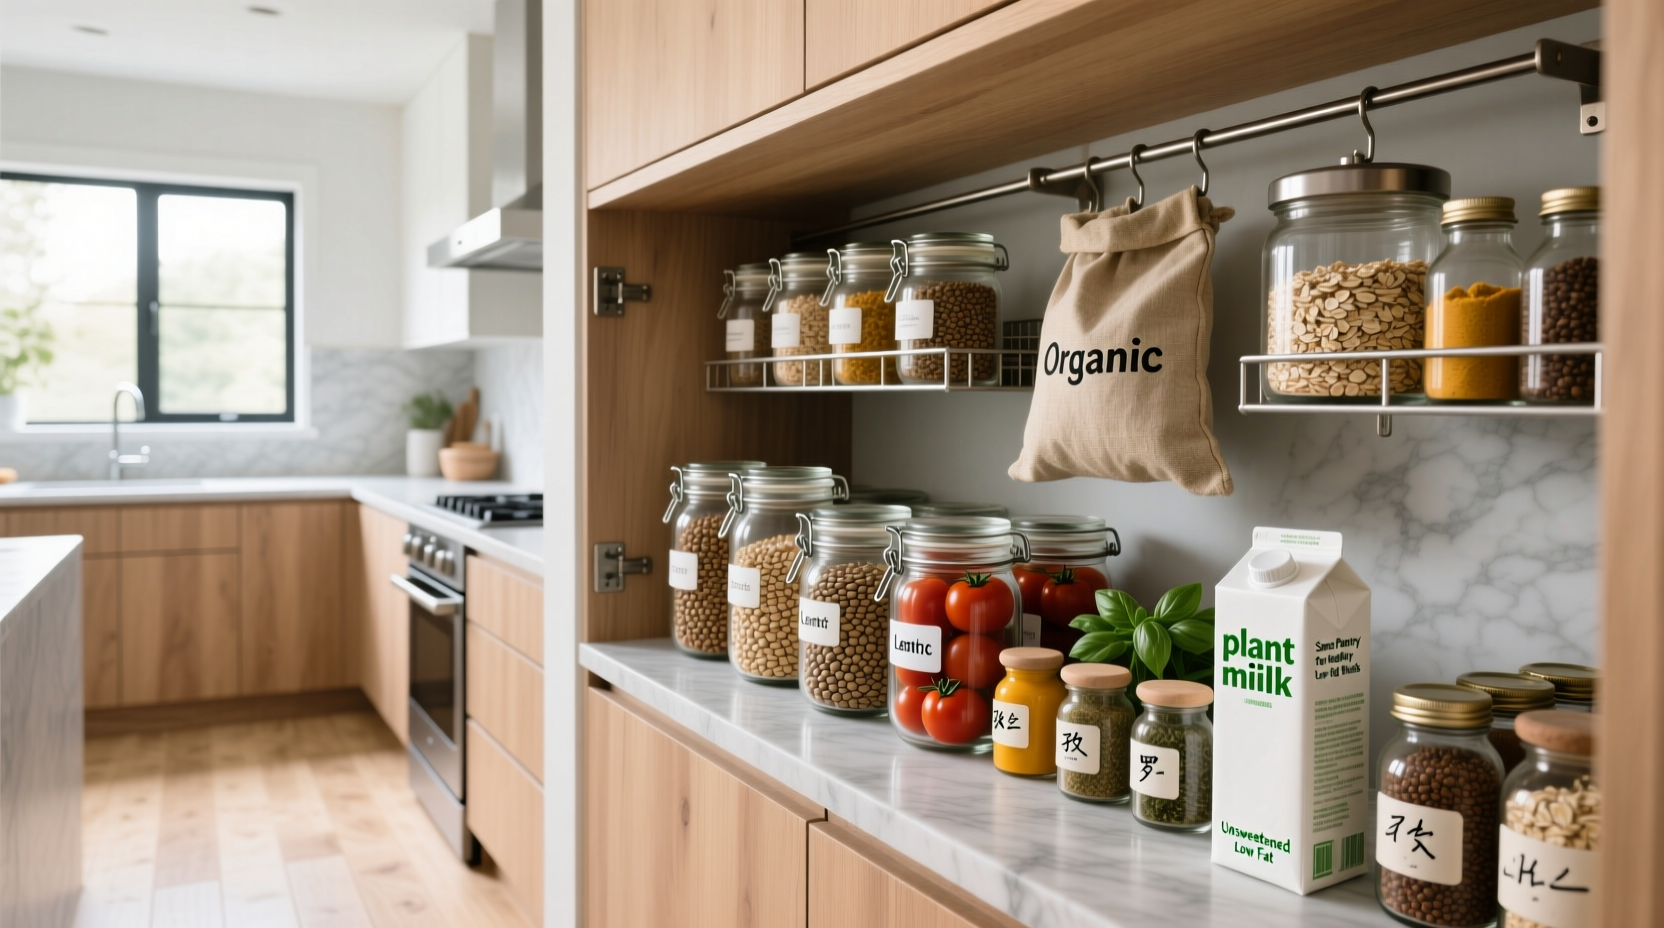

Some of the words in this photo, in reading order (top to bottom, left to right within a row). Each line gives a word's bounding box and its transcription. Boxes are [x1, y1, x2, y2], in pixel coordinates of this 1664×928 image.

[1044, 337, 1163, 386] Organic
[1222, 627, 1295, 665] plant
[1222, 662, 1293, 697] miilk
[1221, 820, 1290, 854] Unsweetened
[1234, 841, 1254, 857] Low
[1257, 847, 1274, 864] Fat
